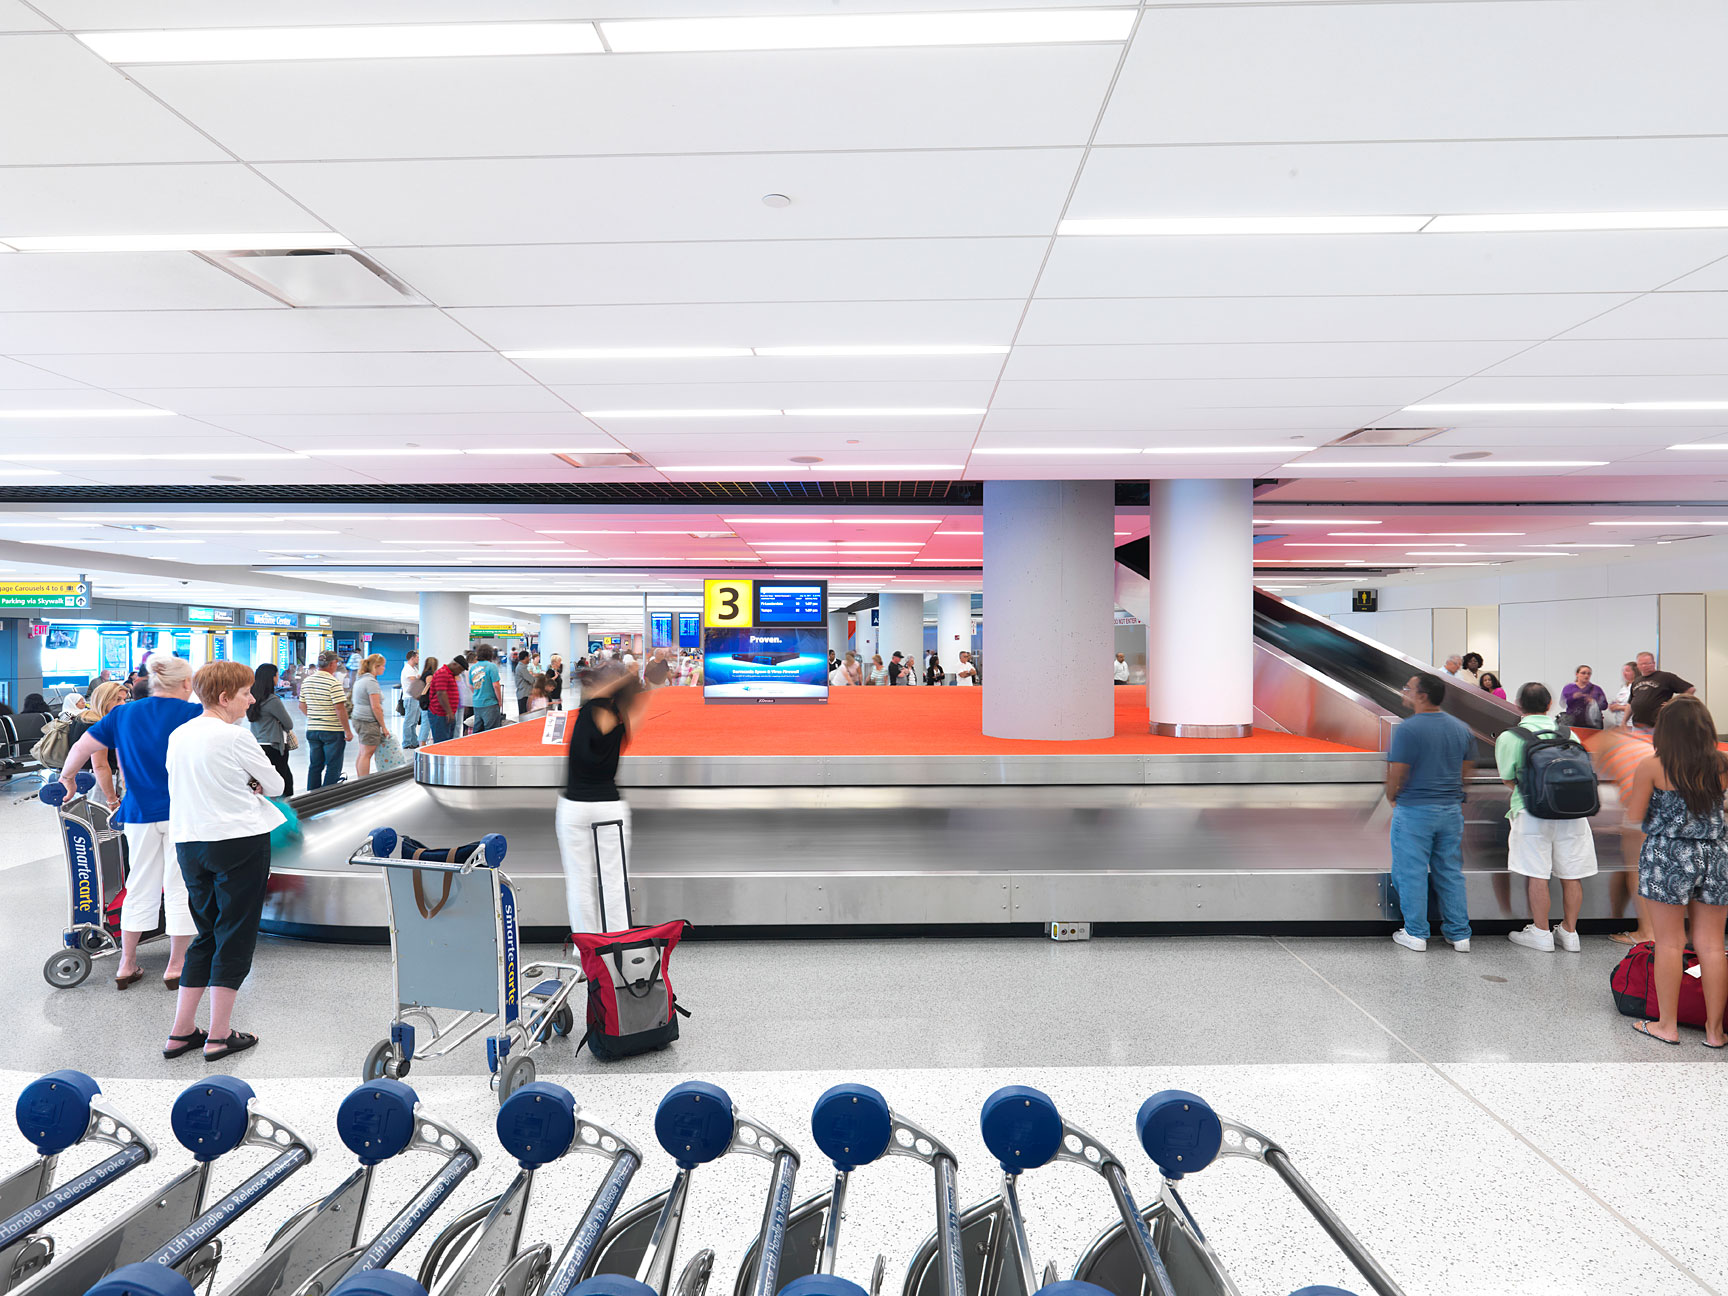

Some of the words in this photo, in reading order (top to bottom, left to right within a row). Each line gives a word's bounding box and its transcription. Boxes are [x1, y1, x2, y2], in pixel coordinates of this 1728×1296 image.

[718, 587, 740, 620] 3
[34, 625, 48, 635] EXIT
[749, 635, 782, 643] Proven.
[0, 1209, 42, 1238] Handle
[42, 1201, 56, 1212] to
[54, 1175, 97, 1203] Release
[95, 1158, 126, 1178] Brake
[158, 1251, 174, 1265] or
[168, 1236, 189, 1255] Lift
[186, 1210, 224, 1241] Handle
[223, 1203, 235, 1214] to
[231, 1177, 268, 1205] Release
[264, 1159, 291, 1181] Brake
[598, 1186, 619, 1214] Release
[363, 1260, 374, 1271] or
[369, 1244, 387, 1262] Lift
[384, 1219, 413, 1249] Handle
[442, 1166, 461, 1186] Brake
[596, 1213, 604, 1223] to
[579, 1221, 600, 1252] Handle
[769, 1223, 784, 1252] Handle
[568, 1264, 579, 1277] or
